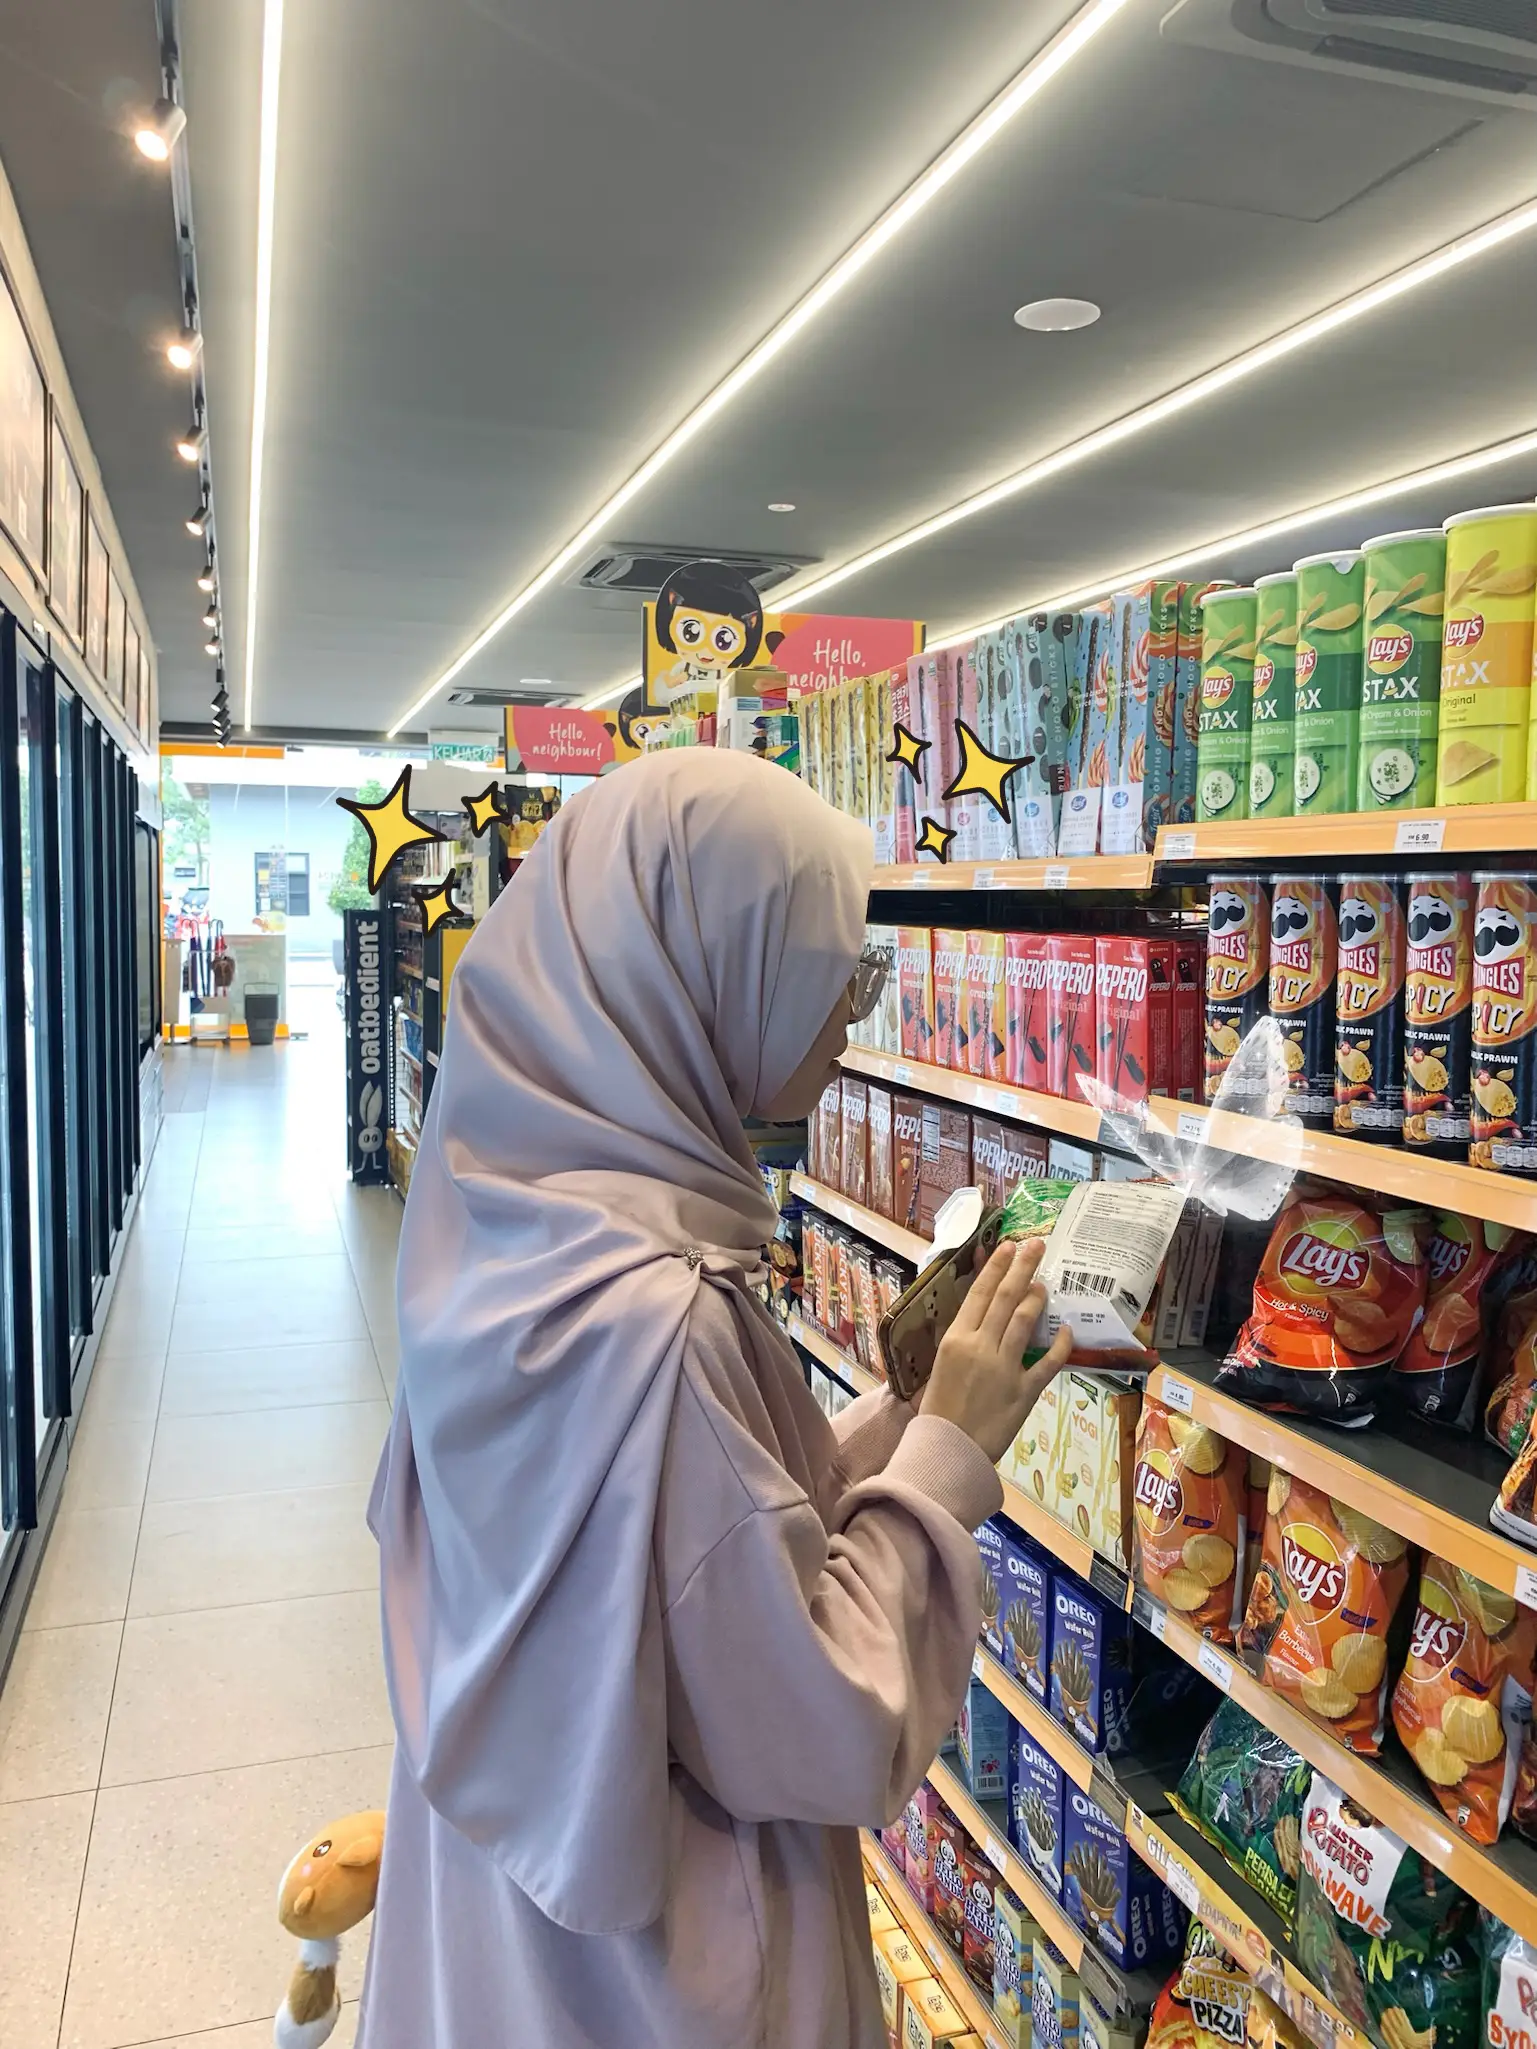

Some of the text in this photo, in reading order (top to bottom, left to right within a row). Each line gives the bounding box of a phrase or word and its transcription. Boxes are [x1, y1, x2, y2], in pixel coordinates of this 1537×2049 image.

[1445, 618, 1482, 646] Lay's
[813, 638, 867, 668] Hello,
[1296, 650, 1316, 675] ay's
[1369, 635, 1410, 662] Lay's
[789, 668, 849, 691] neighb
[1203, 675, 1233, 699] Lay's
[1253, 663, 1272, 687] ay's
[1363, 676, 1419, 703] STAX
[1440, 660, 1491, 690] STAX
[1252, 698, 1278, 721] TAX
[1295, 687, 1322, 712] TAX
[1403, 706, 1432, 717] Onion
[1441, 693, 1476, 709] Original
[549, 722, 587, 742] Hello,
[1199, 710, 1239, 732] STAX
[1310, 716, 1334, 726] Onion
[433, 745, 483, 761] KELUAR
[532, 740, 603, 762] neighbour!
[1415, 833, 1429, 841] 6.90
[900, 947, 931, 976] PEPERO
[934, 951, 967, 979] PEPERO
[967, 953, 1004, 985] PEPERO
[1005, 957, 1047, 991] PEPERO
[1047, 958, 1095, 995] PEPERO
[1096, 963, 1148, 1002] PEPERO
[1149, 982, 1171, 992] PEPERO
[1206, 964, 1248, 993] PICY
[1269, 974, 1311, 1003] PICY
[357, 920, 381, 1075] oatbedient
[1217, 1005, 1244, 1014] PRAWN
[1336, 979, 1379, 1011] PICY
[1405, 980, 1456, 1015] PICY
[1345, 1026, 1374, 1036] PRAWN
[1472, 1000, 1525, 1036] PICY
[1418, 1031, 1450, 1042] PRAWN
[1483, 1054, 1519, 1065] PRAWN
[894, 1113, 921, 1142] PEPE
[972, 1135, 1001, 1172] PEPER
[1000, 1148, 1047, 1179] PEPERO
[1283, 1234, 1365, 1287] Lay's
[838, 1293, 848, 1321] STI
[1299, 1303, 1329, 1322] Spicy
[1041, 1389, 1056, 1408] OGI
[1072, 1411, 1098, 1441] YOGI
[1135, 1463, 1179, 1516] Lay's
[973, 1525, 1002, 1549] OREO
[1007, 1556, 1043, 1586] OREO
[1283, 1536, 1343, 1602] Lay's
[1055, 1593, 1097, 1628] OREO
[1278, 1629, 1316, 1665] Barbecue
[1103, 1688, 1121, 1752] OREO
[1022, 1742, 1058, 1780] OREO
[1307, 1806, 1370, 1887] POTATO
[934, 1855, 963, 1891] HELLO
[1245, 1846, 1279, 1893] PERISA
[934, 1869, 966, 1902] PANDA
[1325, 1867, 1389, 1938] WAVE
[964, 1907, 995, 1941] PAND
[1131, 1896, 1147, 1959] OREO
[1181, 1970, 1253, 2015] CHEESY
